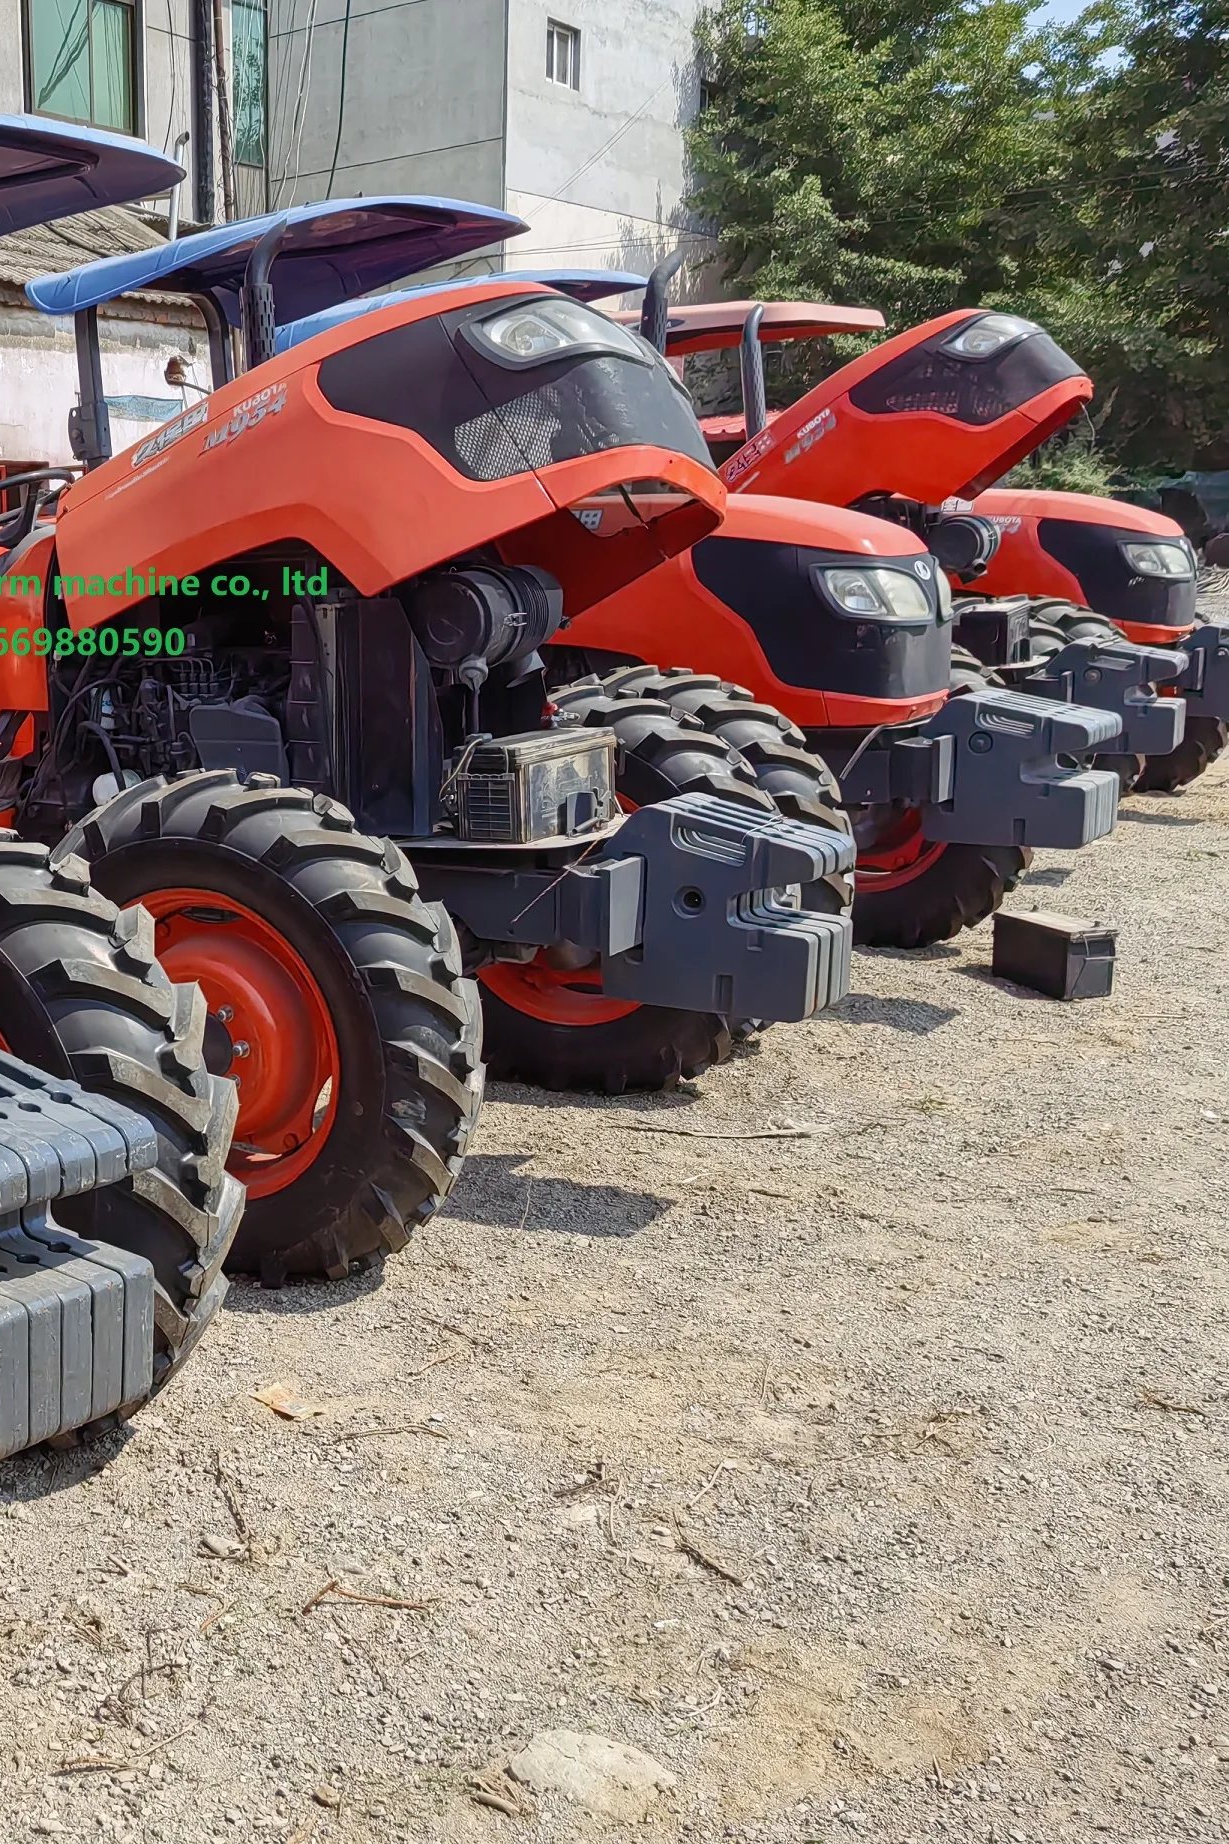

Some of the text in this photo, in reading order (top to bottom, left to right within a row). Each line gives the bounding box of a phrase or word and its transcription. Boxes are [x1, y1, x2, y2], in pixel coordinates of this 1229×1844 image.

[233, 382, 287, 417] KUBOTA
[198, 390, 287, 457] M954
[796, 408, 831, 438] KUBOTA
